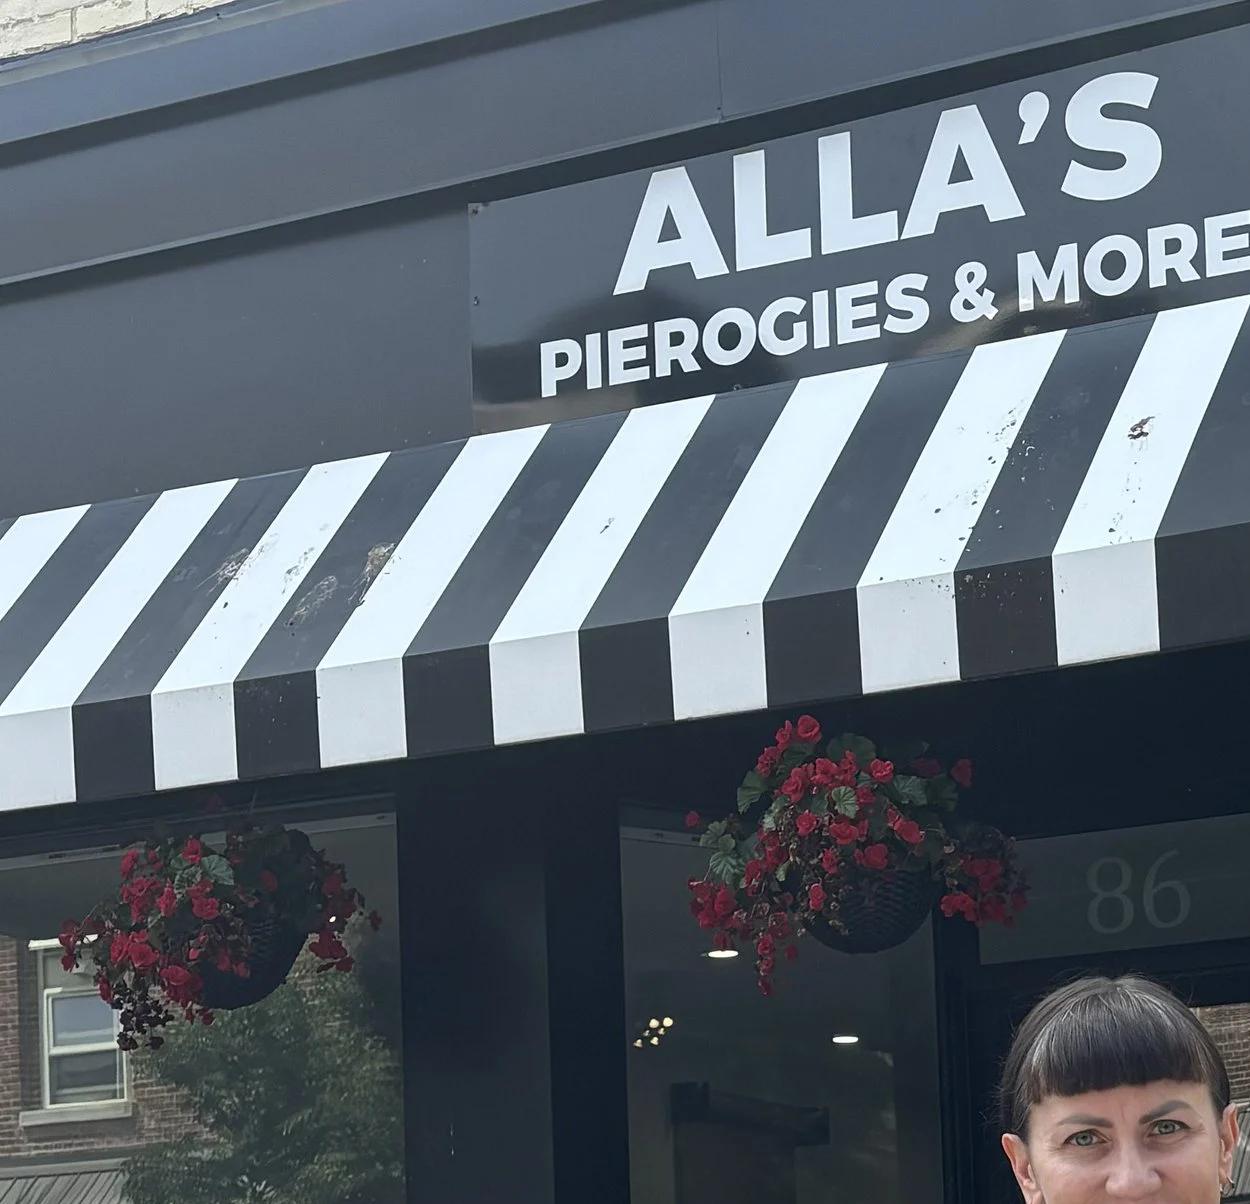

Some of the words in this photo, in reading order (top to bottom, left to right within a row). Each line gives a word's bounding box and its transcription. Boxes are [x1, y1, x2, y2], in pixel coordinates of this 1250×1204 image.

[613, 72, 1163, 295] ALLA'S
[541, 273, 930, 397] PIEROGIES
[949, 261, 999, 320] &
[1085, 849, 1191, 935] 86
